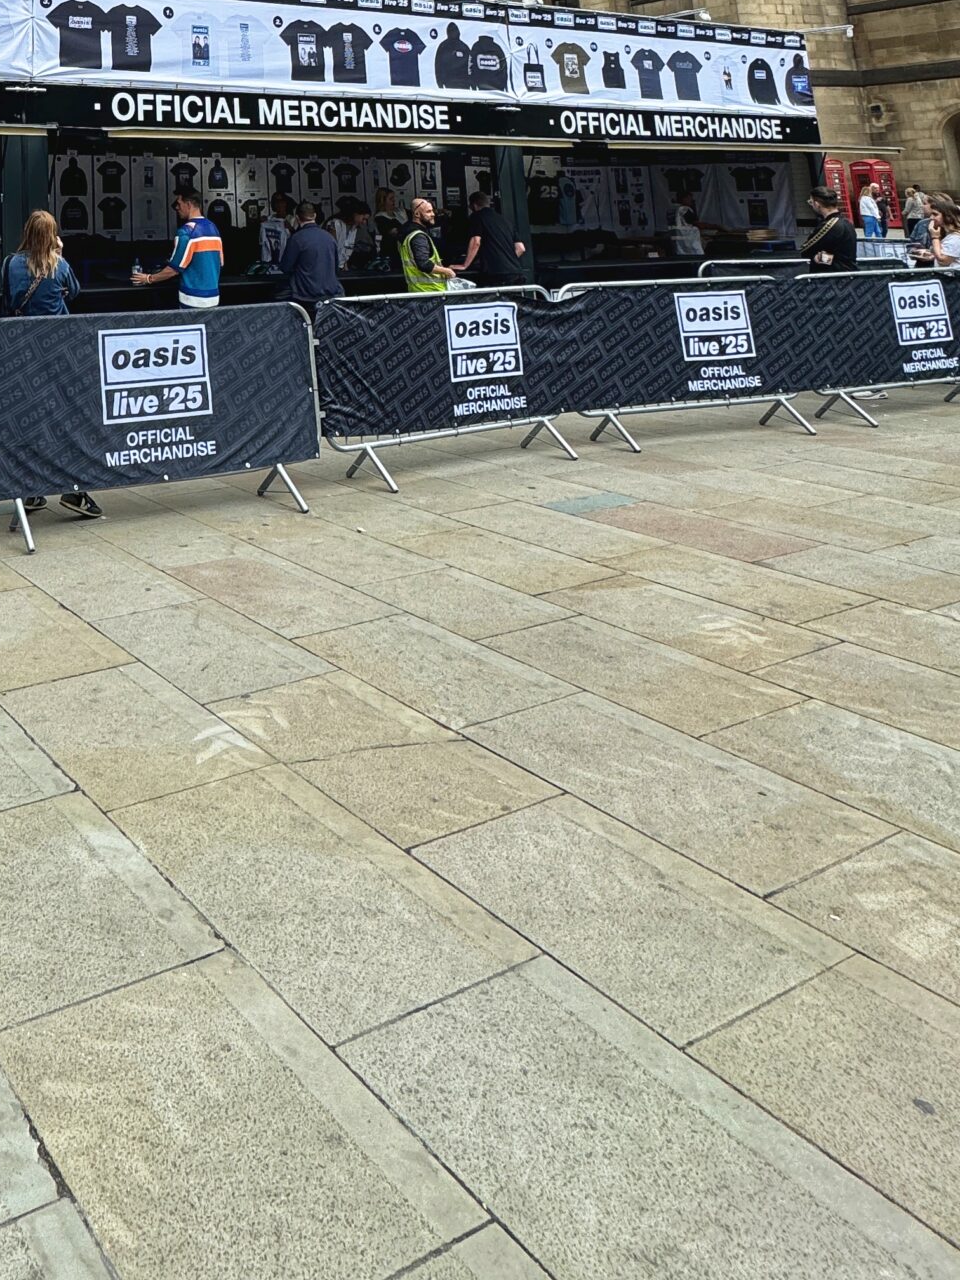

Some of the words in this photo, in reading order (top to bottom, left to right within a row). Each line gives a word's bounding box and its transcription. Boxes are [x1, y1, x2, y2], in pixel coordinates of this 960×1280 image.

[111, 92, 250, 125] OFFICIAL
[258, 98, 450, 130] MERCHANDISE
[560, 110, 651, 137] OFFICIAL
[655, 117, 783, 140] MERCHANDISE
[540, 185, 559, 198] 25
[898, 288, 940, 310] oasis
[685, 301, 741, 323] oasis
[455, 313, 511, 339] oasis
[901, 322, 926, 341] live
[112, 339, 196, 370] oasis
[689, 338, 719, 357] live
[911, 346, 947, 362] OFFICIAL
[456, 355, 488, 376] live
[700, 365, 746, 378] OFFICIAL
[903, 357, 959, 374] MERCHANDISE
[466, 384, 512, 400] OFFICIAL
[688, 376, 762, 393] MERCHANDISE
[113, 391, 159, 417] live
[454, 396, 527, 417] MERCHANDISE
[126, 426, 194, 447] OFFICIAL
[105, 440, 217, 468] MERCHANDISE
